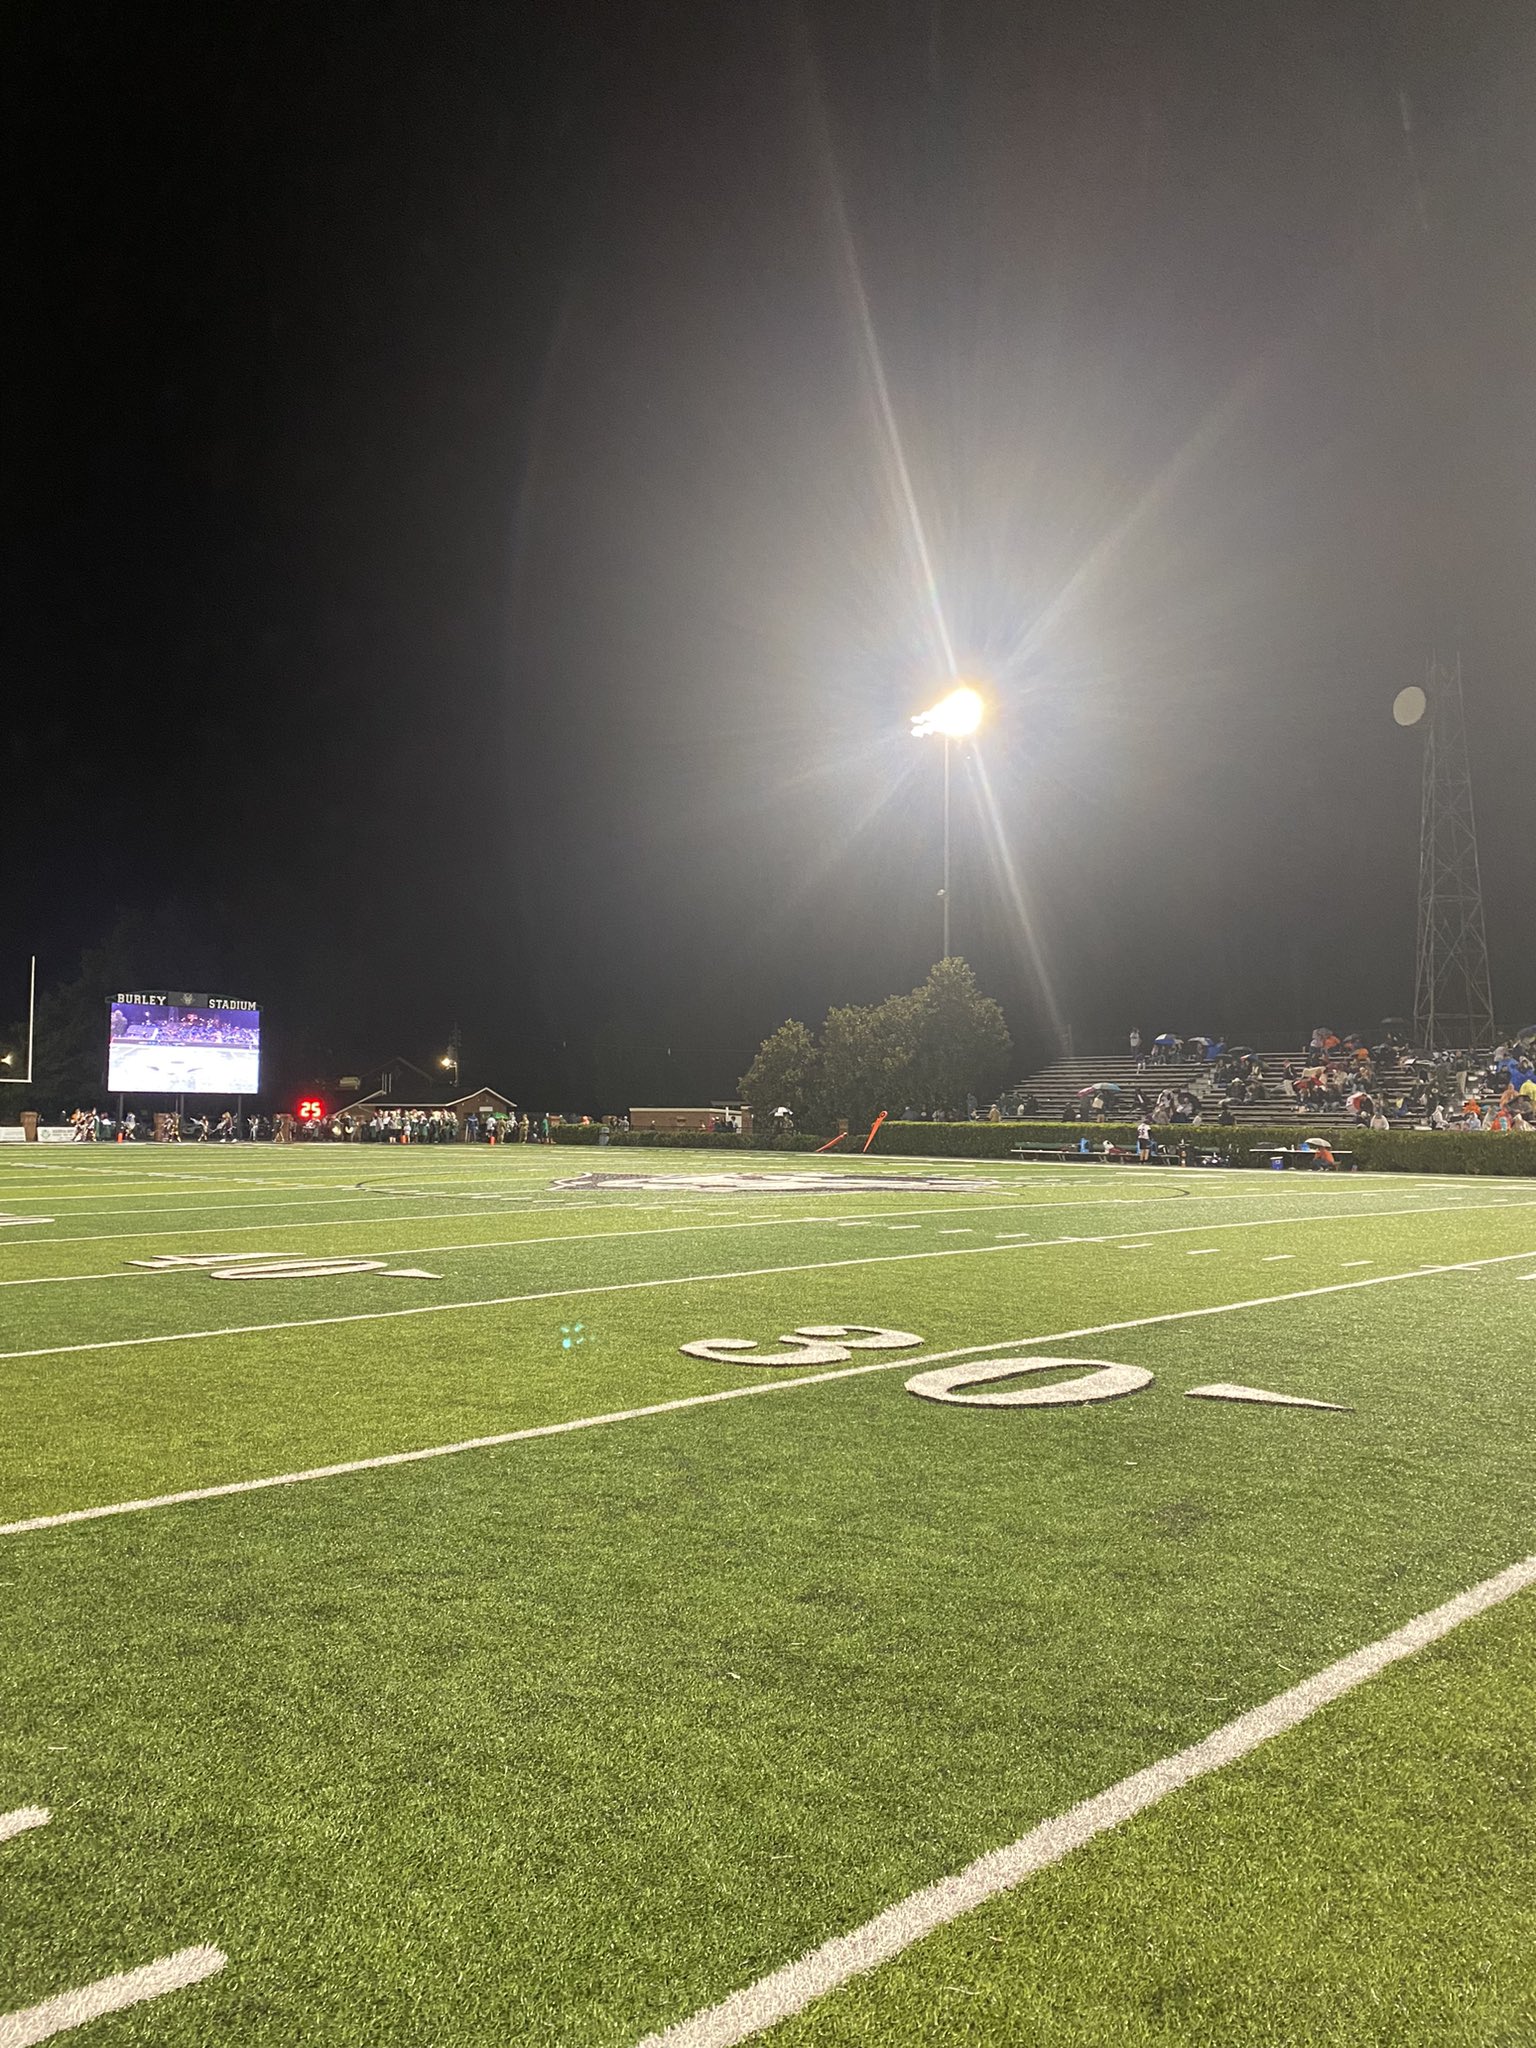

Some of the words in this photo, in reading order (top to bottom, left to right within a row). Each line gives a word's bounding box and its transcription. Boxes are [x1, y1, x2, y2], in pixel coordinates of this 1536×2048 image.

[117, 993, 167, 1006] BURLEY
[208, 998, 257, 1011] STADIUM
[300, 1101, 321, 1117] 25
